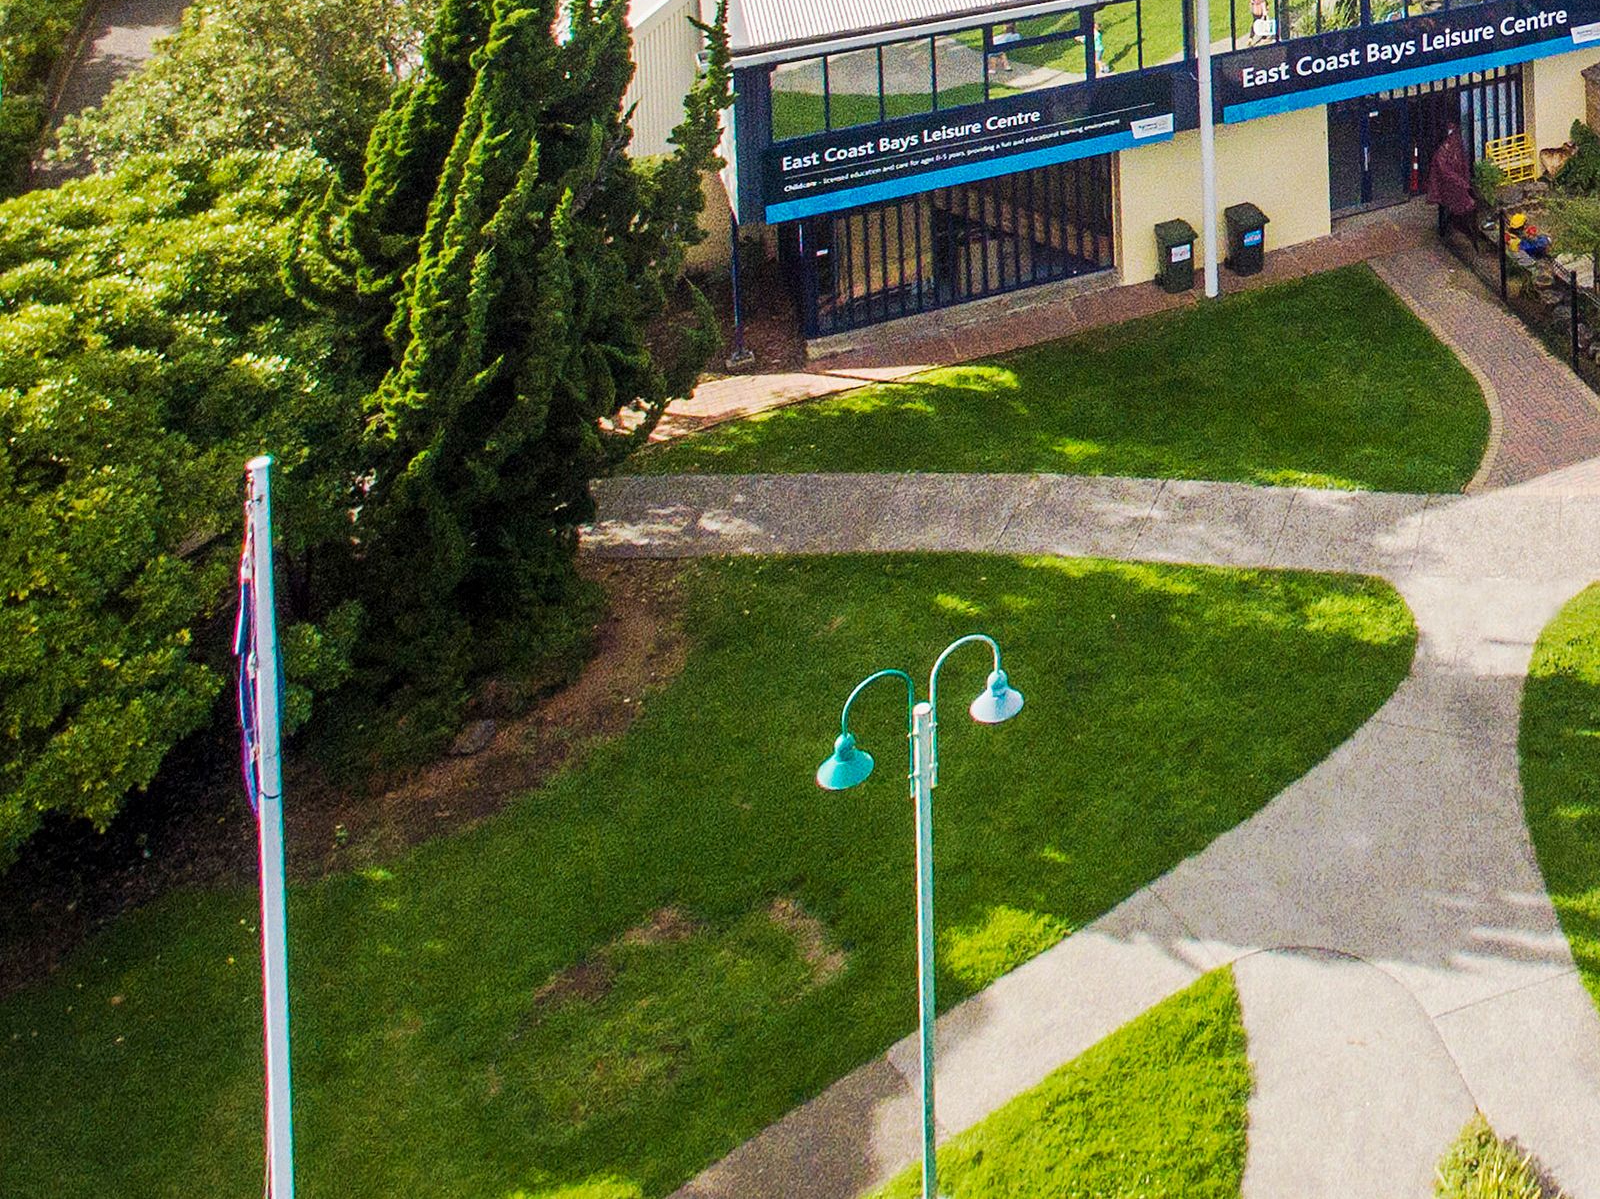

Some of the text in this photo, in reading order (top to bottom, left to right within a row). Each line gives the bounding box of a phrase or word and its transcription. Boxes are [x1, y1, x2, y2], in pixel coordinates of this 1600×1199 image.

[1242, 10, 1568, 88] East Coast Bays Leisure Centre
[782, 111, 1040, 171] East Coast Bays Leisure Centre
[784, 181, 817, 192] Childcare
[850, 168, 881, 179] education
[882, 164, 895, 172] and
[895, 162, 908, 170] care
[967, 144, 995, 156] providing
[1012, 138, 1024, 146] and
[1025, 131, 1059, 144] educational
